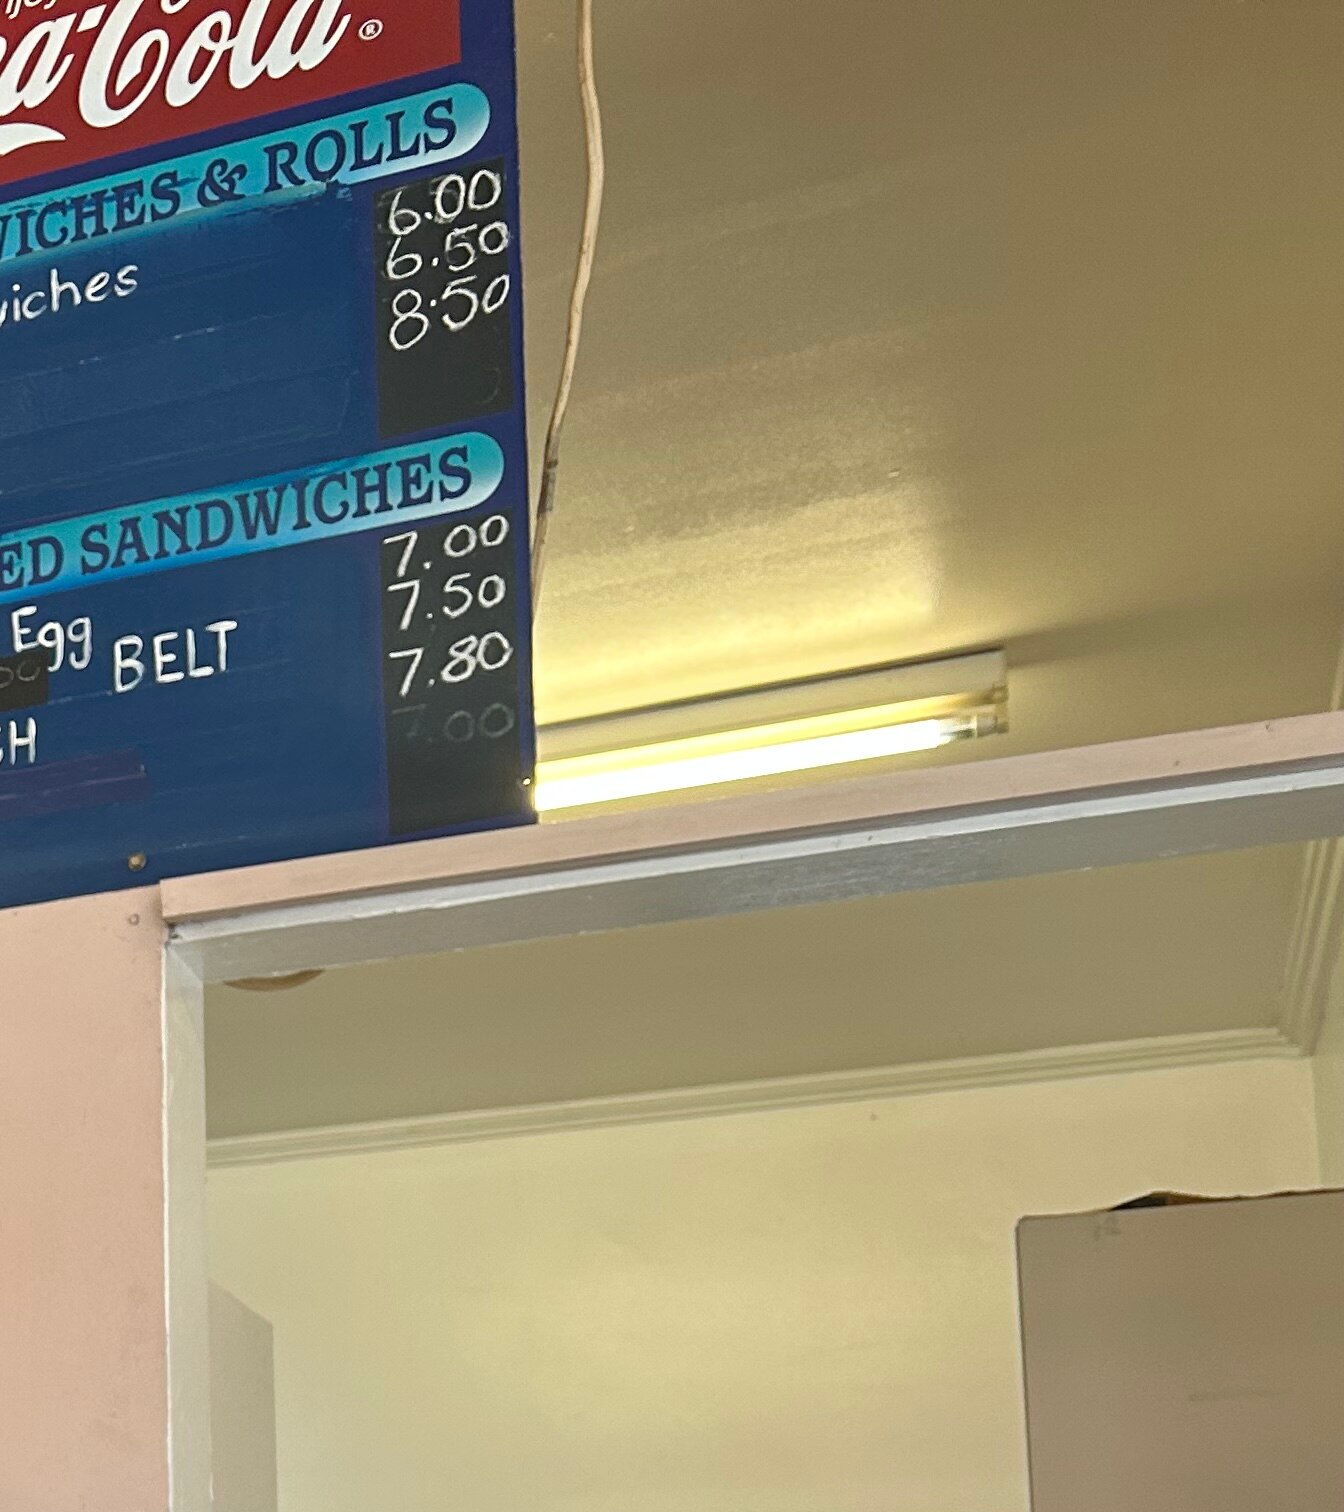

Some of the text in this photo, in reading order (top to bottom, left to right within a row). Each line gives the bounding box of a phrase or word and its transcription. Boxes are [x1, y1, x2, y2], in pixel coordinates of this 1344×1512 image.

[196, 159, 248, 208] &
[262, 97, 459, 194] ROLLS
[389, 169, 502, 235] 6.00
[386, 221, 510, 280] 6.50
[389, 273, 510, 350] 8.50
[80, 446, 473, 576] SANDWICHES
[383, 514, 509, 577] 7.00
[387, 573, 506, 630] 7.50
[12, 605, 93, 673] Egg
[112, 620, 238, 694] BELT
[389, 631, 513, 697] 7.80
